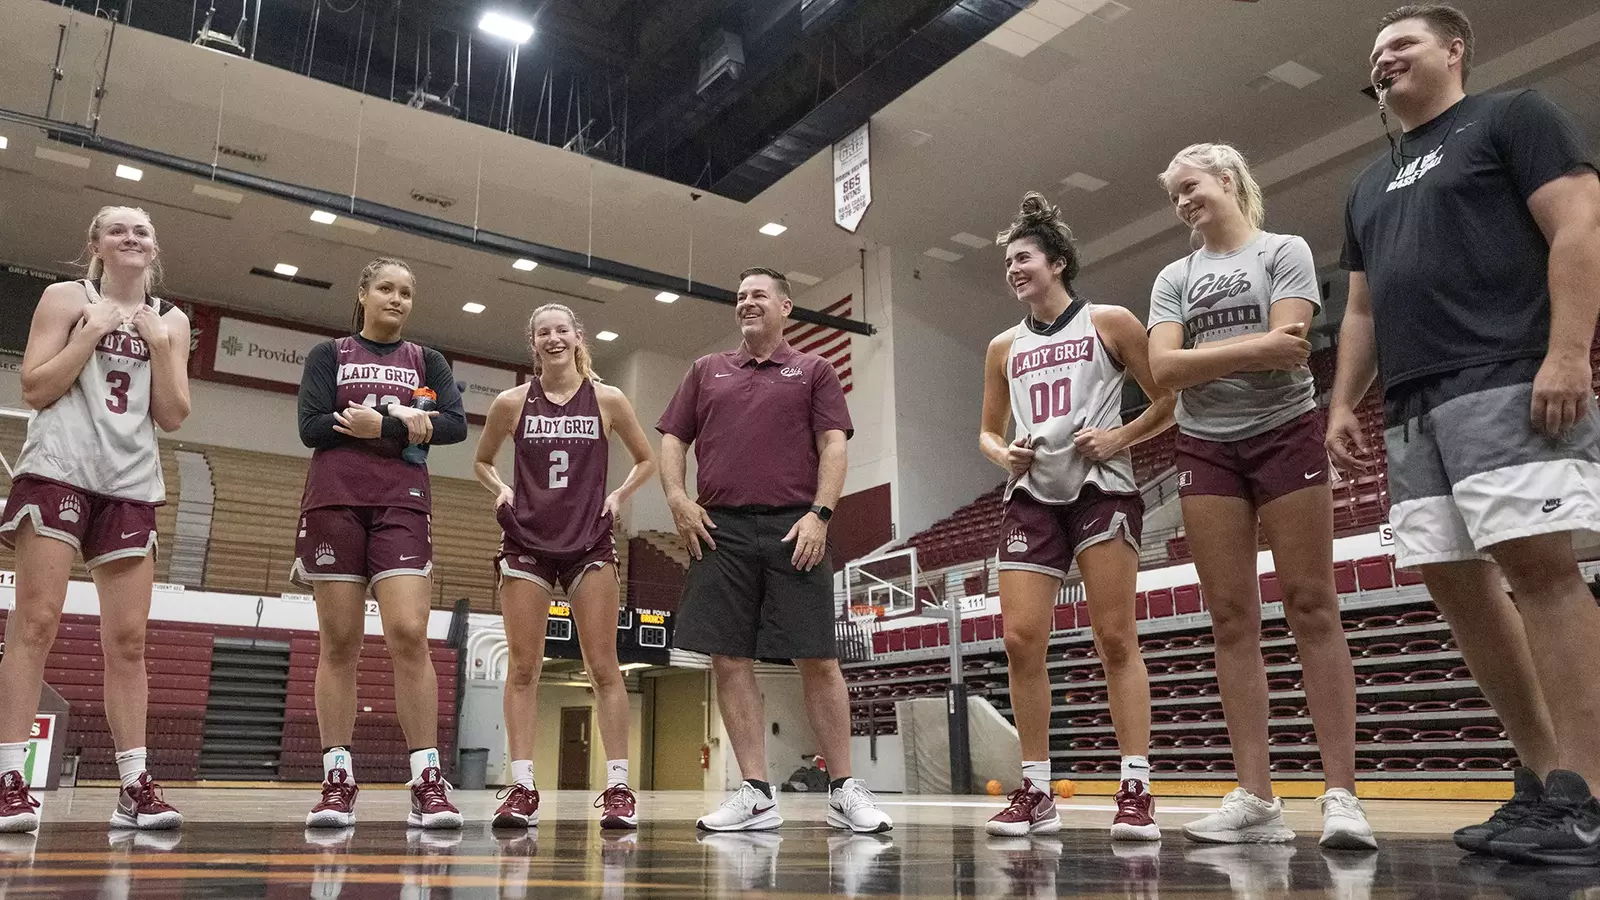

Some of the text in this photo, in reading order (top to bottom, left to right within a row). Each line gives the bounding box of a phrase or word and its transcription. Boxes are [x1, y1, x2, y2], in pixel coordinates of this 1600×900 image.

[843, 173, 860, 193] 865
[843, 186, 861, 202] WINS
[1188, 268, 1252, 304] Griz
[1189, 308, 1257, 334] MONTANA
[1016, 339, 1089, 374] LADY GRIZ
[341, 366, 416, 386] LADY GRIZ
[105, 370, 131, 415] 3
[1029, 377, 1072, 424] 00
[526, 419, 594, 435] LADY GRIZ
[549, 450, 569, 489] 2
[1382, 527, 1393, 540] S
[652, 609, 671, 617] FOULS
